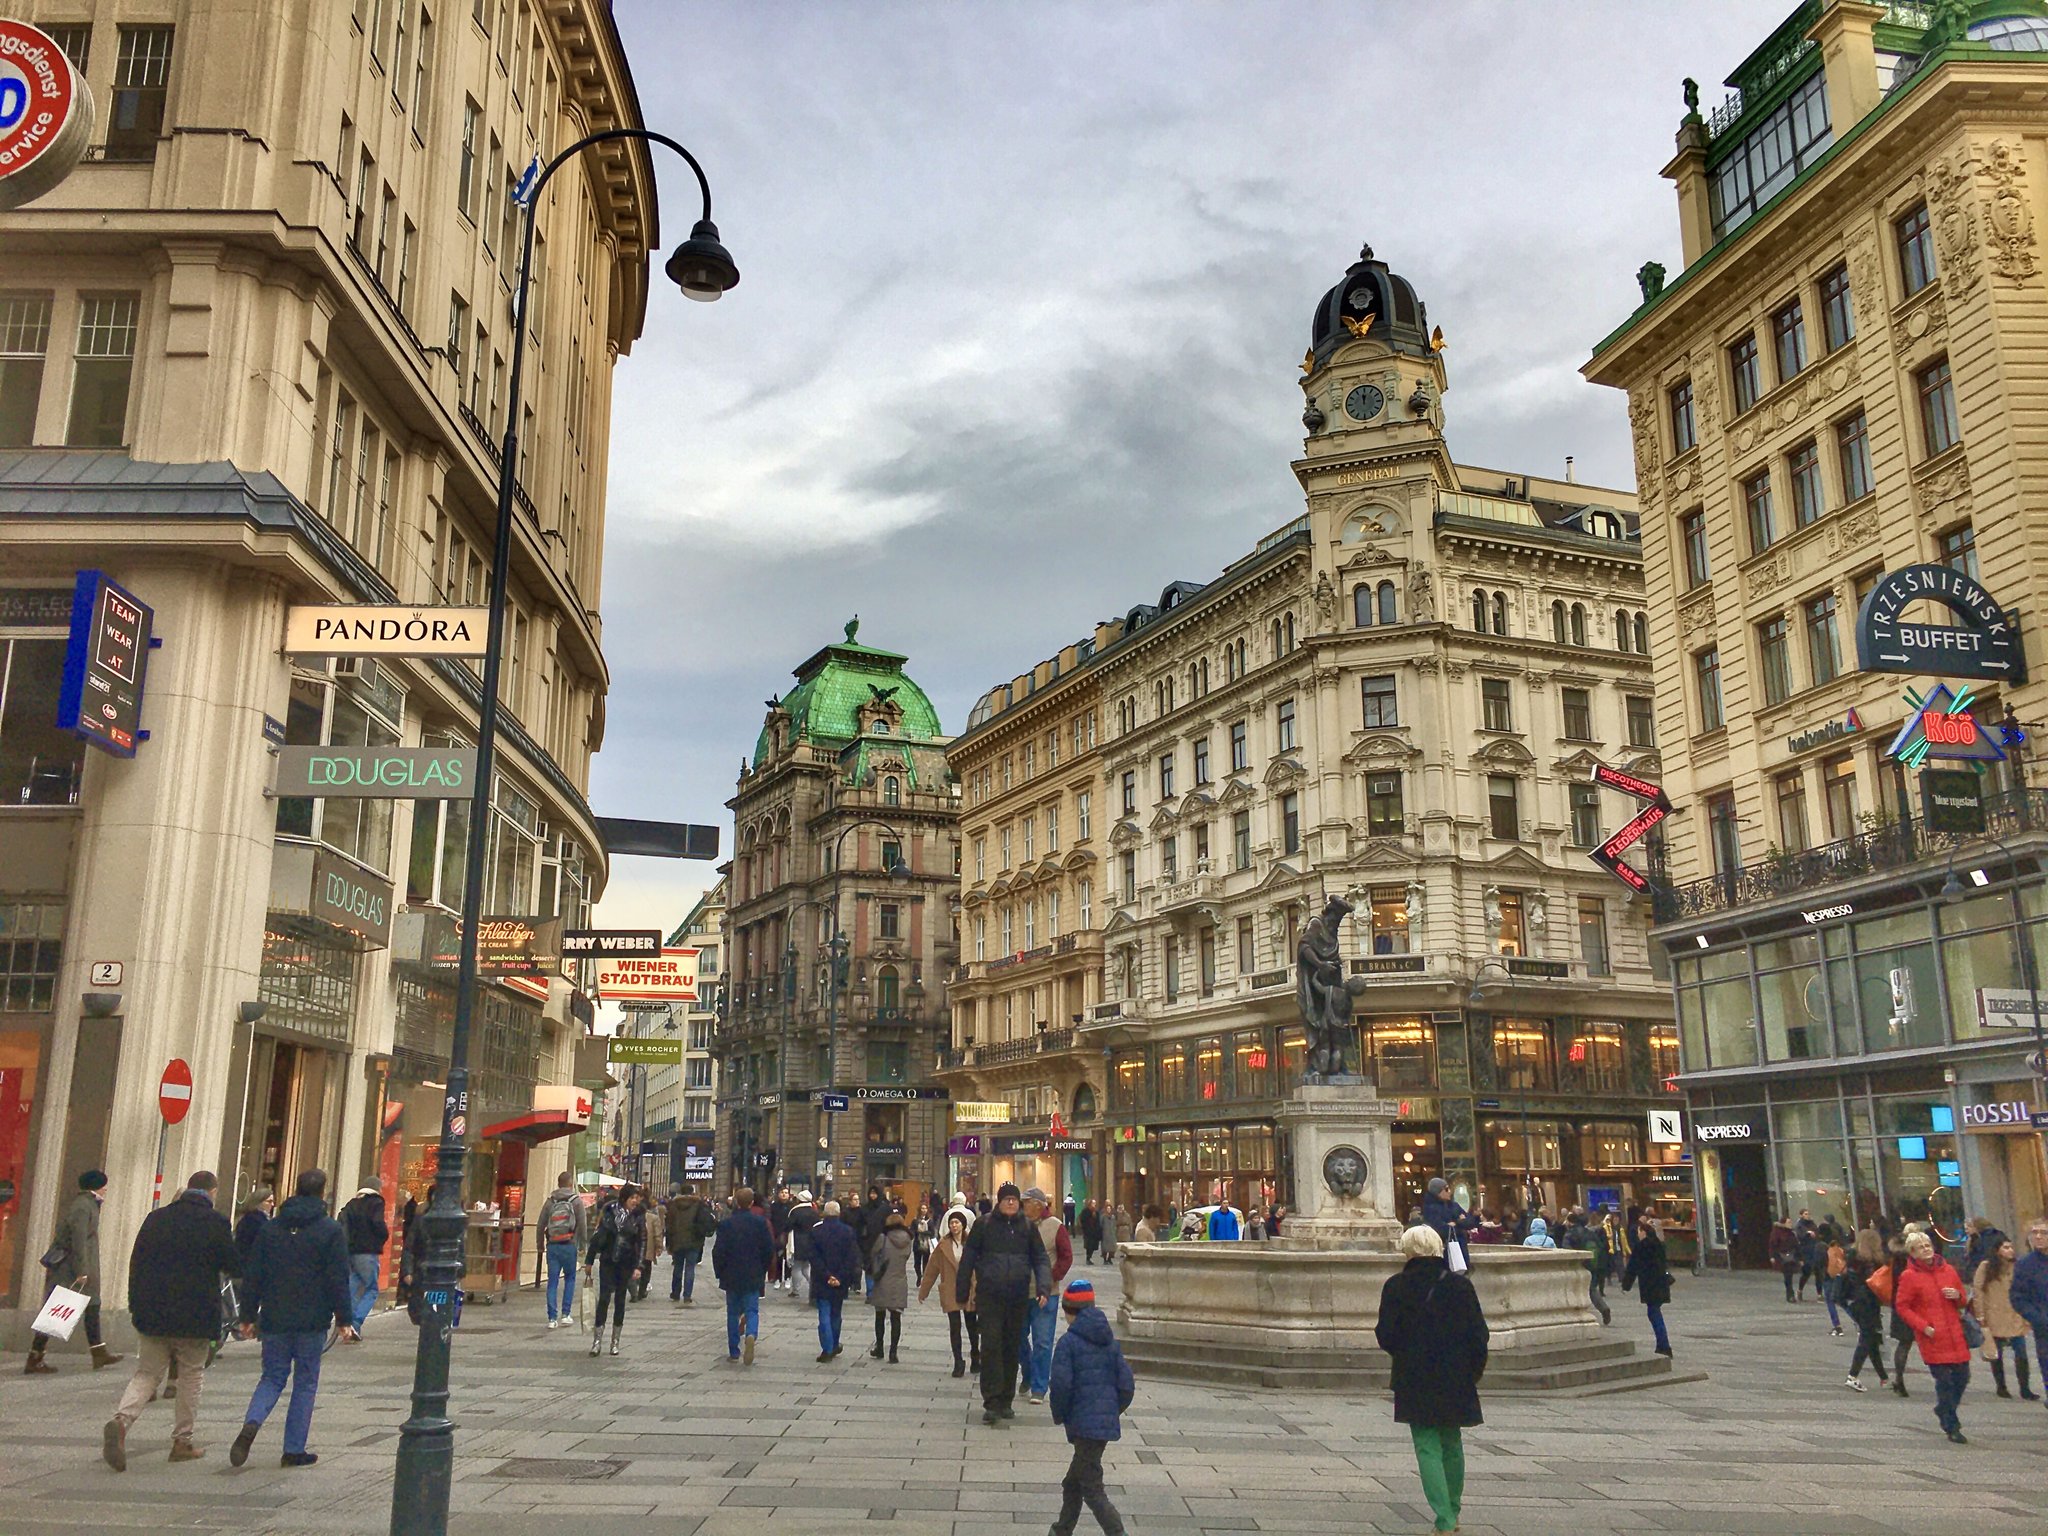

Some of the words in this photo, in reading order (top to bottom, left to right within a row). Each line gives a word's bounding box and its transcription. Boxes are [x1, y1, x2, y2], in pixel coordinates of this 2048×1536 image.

[1337, 467, 1400, 486] GENERALI
[111, 598, 135, 625] TEAM
[106, 624, 133, 649] WEAR
[315, 618, 471, 641] PANDORA
[1900, 629, 1982, 651] BUFFET
[108, 655, 123, 669] .AT
[1788, 720, 1843, 753] helvetia
[308, 757, 463, 787] DOUGLAS
[1600, 769, 1659, 795] DISCOTHEQUE
[1605, 808, 1664, 859] FLEDERMAUS
[1617, 863, 1634, 878] BAR
[326, 873, 383, 926] DOUGLAS
[1801, 904, 1853, 925] NESPRESSO
[600, 937, 654, 950] WEBER
[102, 964, 112, 978] 2
[617, 960, 678, 973] WIENER
[1369, 962, 1397, 970] BRAUN
[600, 974, 694, 987] STADTBRÄU
[870, 1089, 904, 1098] OMEGA
[960, 1104, 1007, 1118] STURMAYR
[1962, 1101, 2031, 1124] FOSSIL
[1695, 1124, 1751, 1142] NESPRESSO
[1054, 1142, 1086, 1150] APOTHEKE
